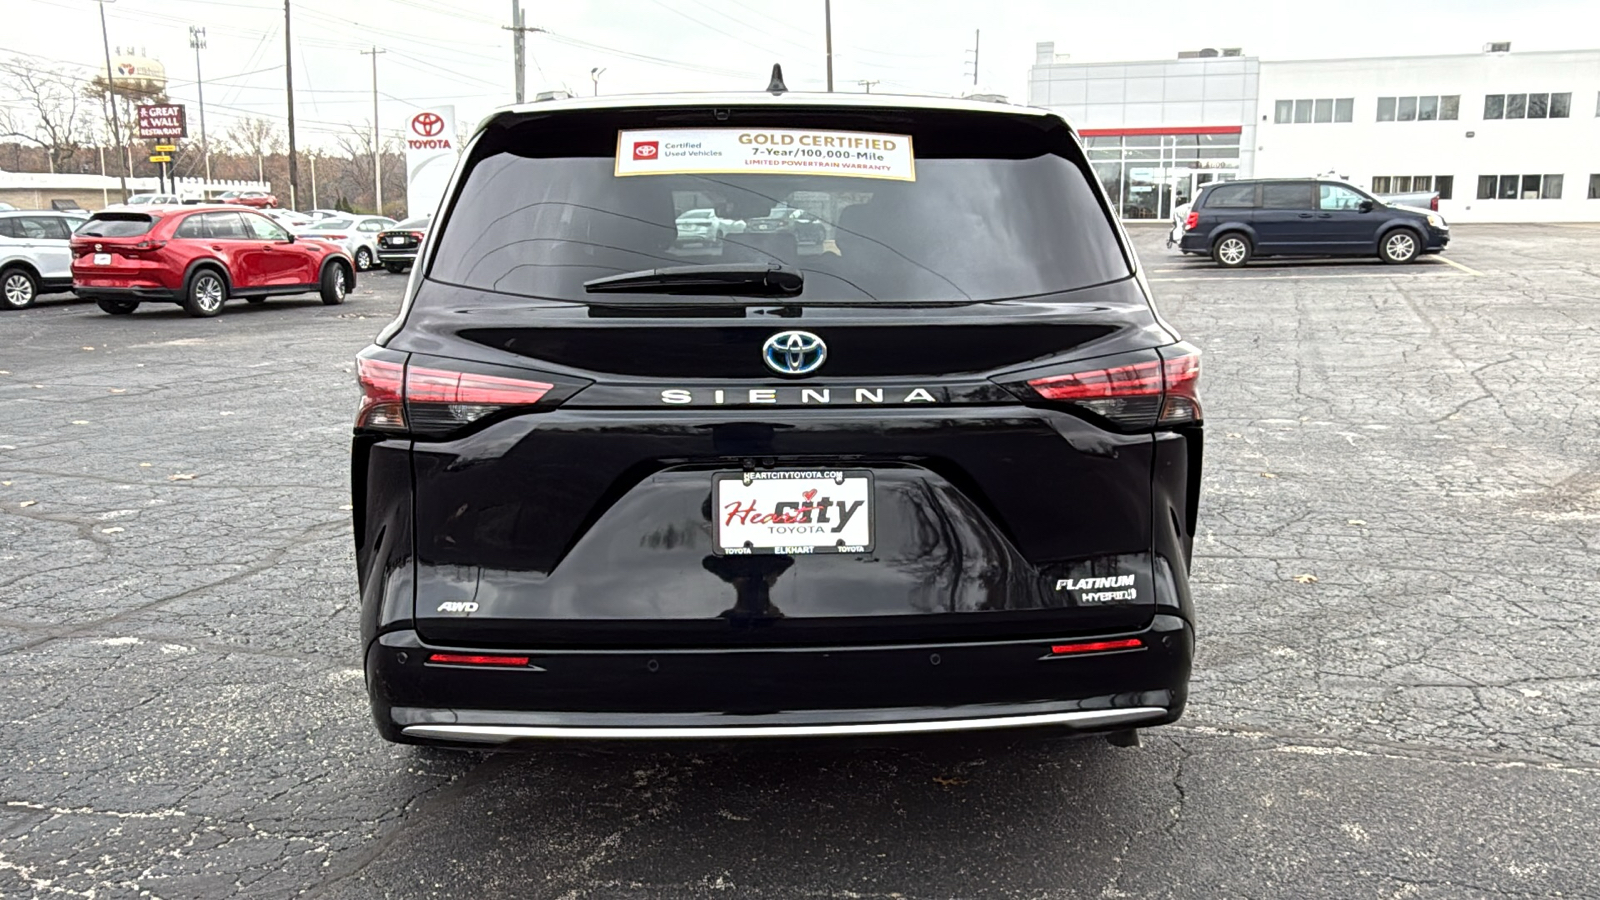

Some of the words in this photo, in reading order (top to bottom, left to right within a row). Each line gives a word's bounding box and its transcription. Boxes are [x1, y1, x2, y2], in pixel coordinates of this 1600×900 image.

[149, 107, 179, 117] GREAT
[150, 117, 179, 127] WALL
[407, 139, 452, 150] TOYOTA
[738, 133, 794, 145] GOLD
[799, 135, 897, 151] CERTIFIED
[688, 149, 722, 157] Vehicles
[752, 147, 884, 161] 7-Year/100,000-Mile
[781, 160, 840, 168] POWERTRAIN
[841, 162, 892, 171] WARRANTY
[661, 388, 936, 404] SIENNA
[743, 471, 843, 480] HEARTCITYTOYOTA.COM
[724, 499, 825, 527] Heart
[768, 526, 825, 534] TOYOTA
[724, 547, 752, 555] TOYOTA
[774, 546, 815, 555] ELKHART
[1056, 574, 1135, 590] PLATINUM
[1082, 590, 1128, 602] HYBRID
[437, 601, 479, 612] AWD
